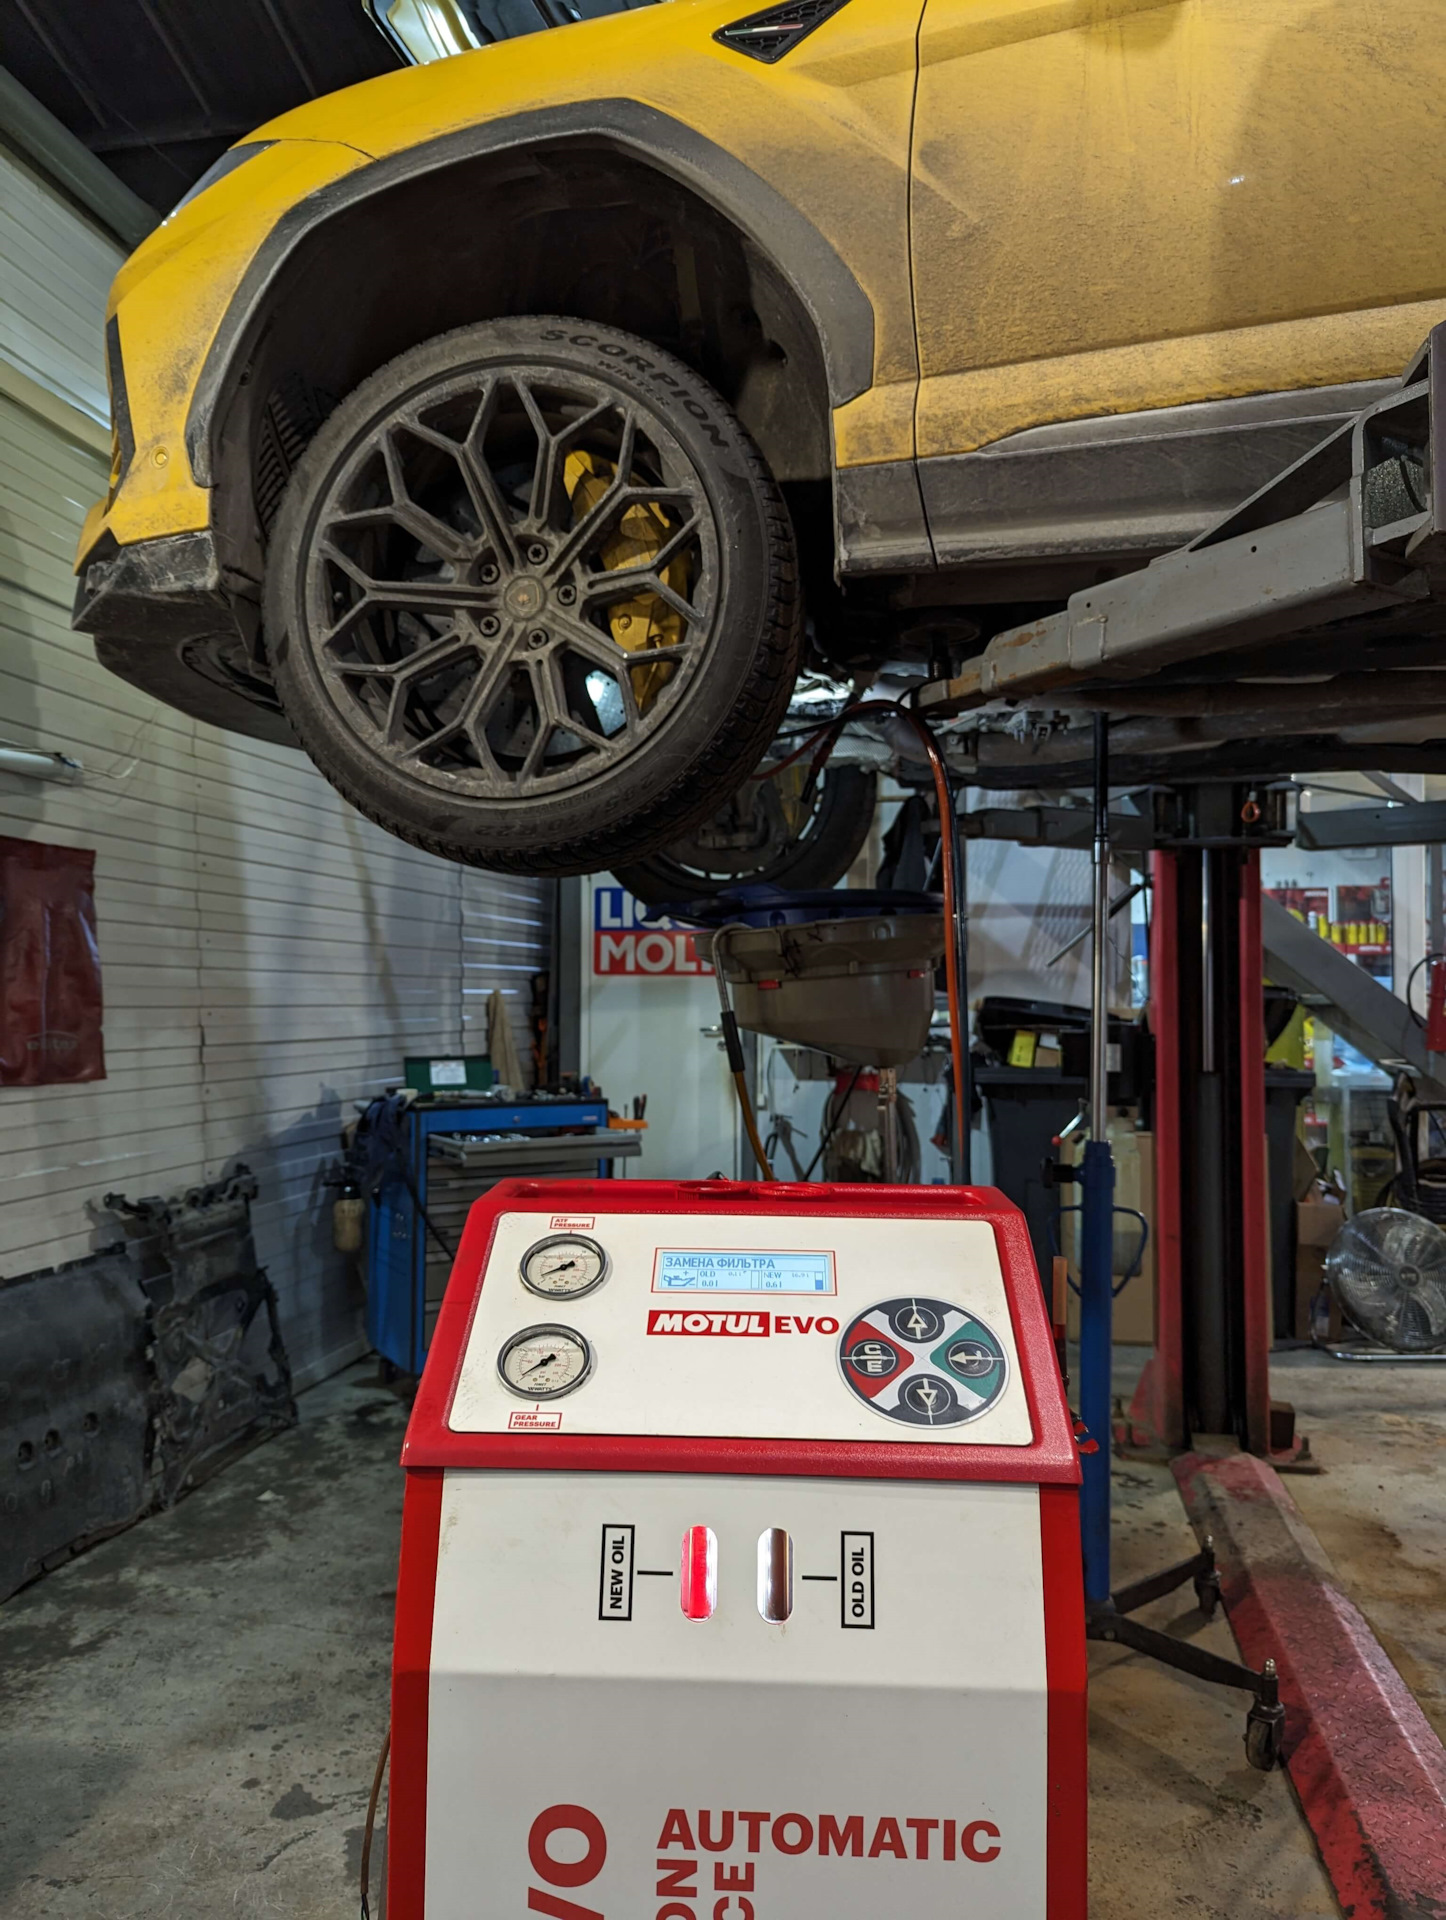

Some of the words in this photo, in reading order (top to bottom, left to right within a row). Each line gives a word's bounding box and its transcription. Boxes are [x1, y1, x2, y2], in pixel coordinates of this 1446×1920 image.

[540, 329, 730, 448] SCORPION
[600, 890, 697, 931] LIQ
[600, 934, 715, 972] MOL
[665, 1257, 714, 1268] ЗАМЕНА
[717, 1258, 775, 1269] ФИЛЬТРА
[652, 1313, 765, 1334] MOTUL
[775, 1315, 839, 1334] EVO
[612, 1535, 625, 1565] OIL
[851, 1547, 864, 1580] OIL
[610, 1570, 623, 1609] NEW
[851, 1582, 864, 1618] OLD
[656, 1808, 1001, 1863] AUTOMATIC
